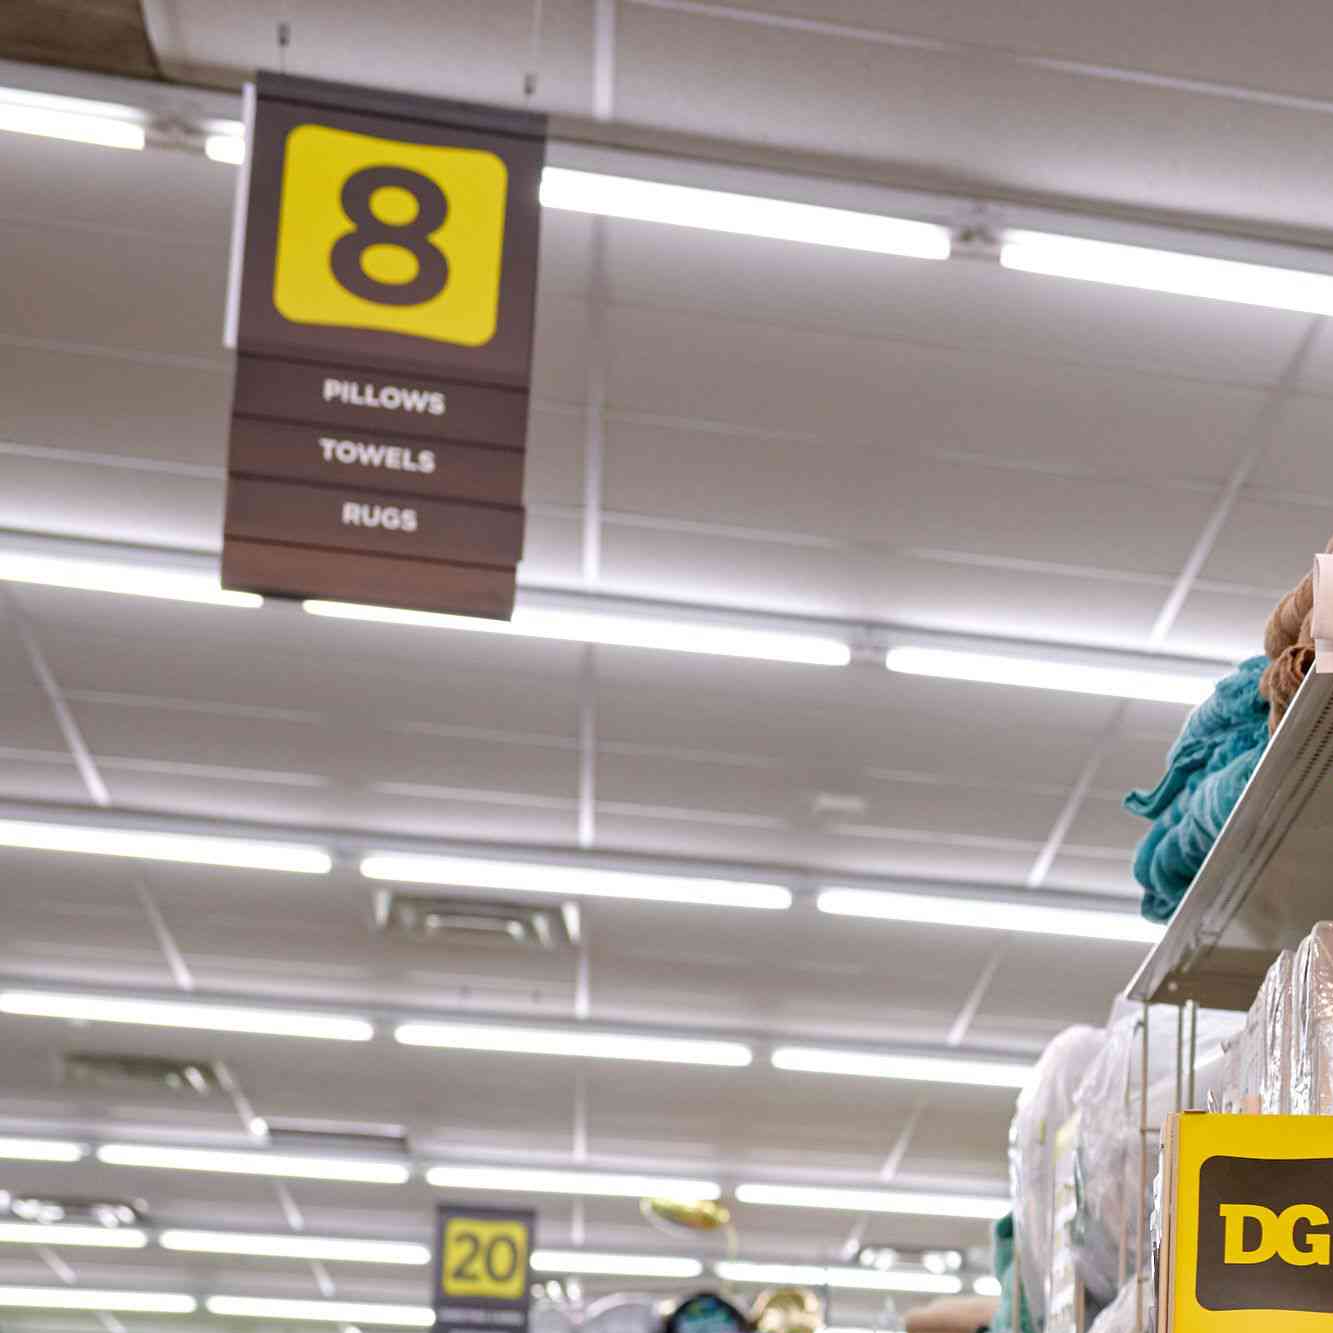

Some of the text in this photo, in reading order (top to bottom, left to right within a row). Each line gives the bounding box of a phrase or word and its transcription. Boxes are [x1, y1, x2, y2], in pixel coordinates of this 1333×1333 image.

[329, 164, 451, 308] 8
[322, 377, 447, 416] PILLOWS
[318, 437, 437, 475] TOWELS
[341, 502, 419, 533] RUGS
[452, 1231, 518, 1284] 20
[1219, 1203, 1332, 1267] DG
